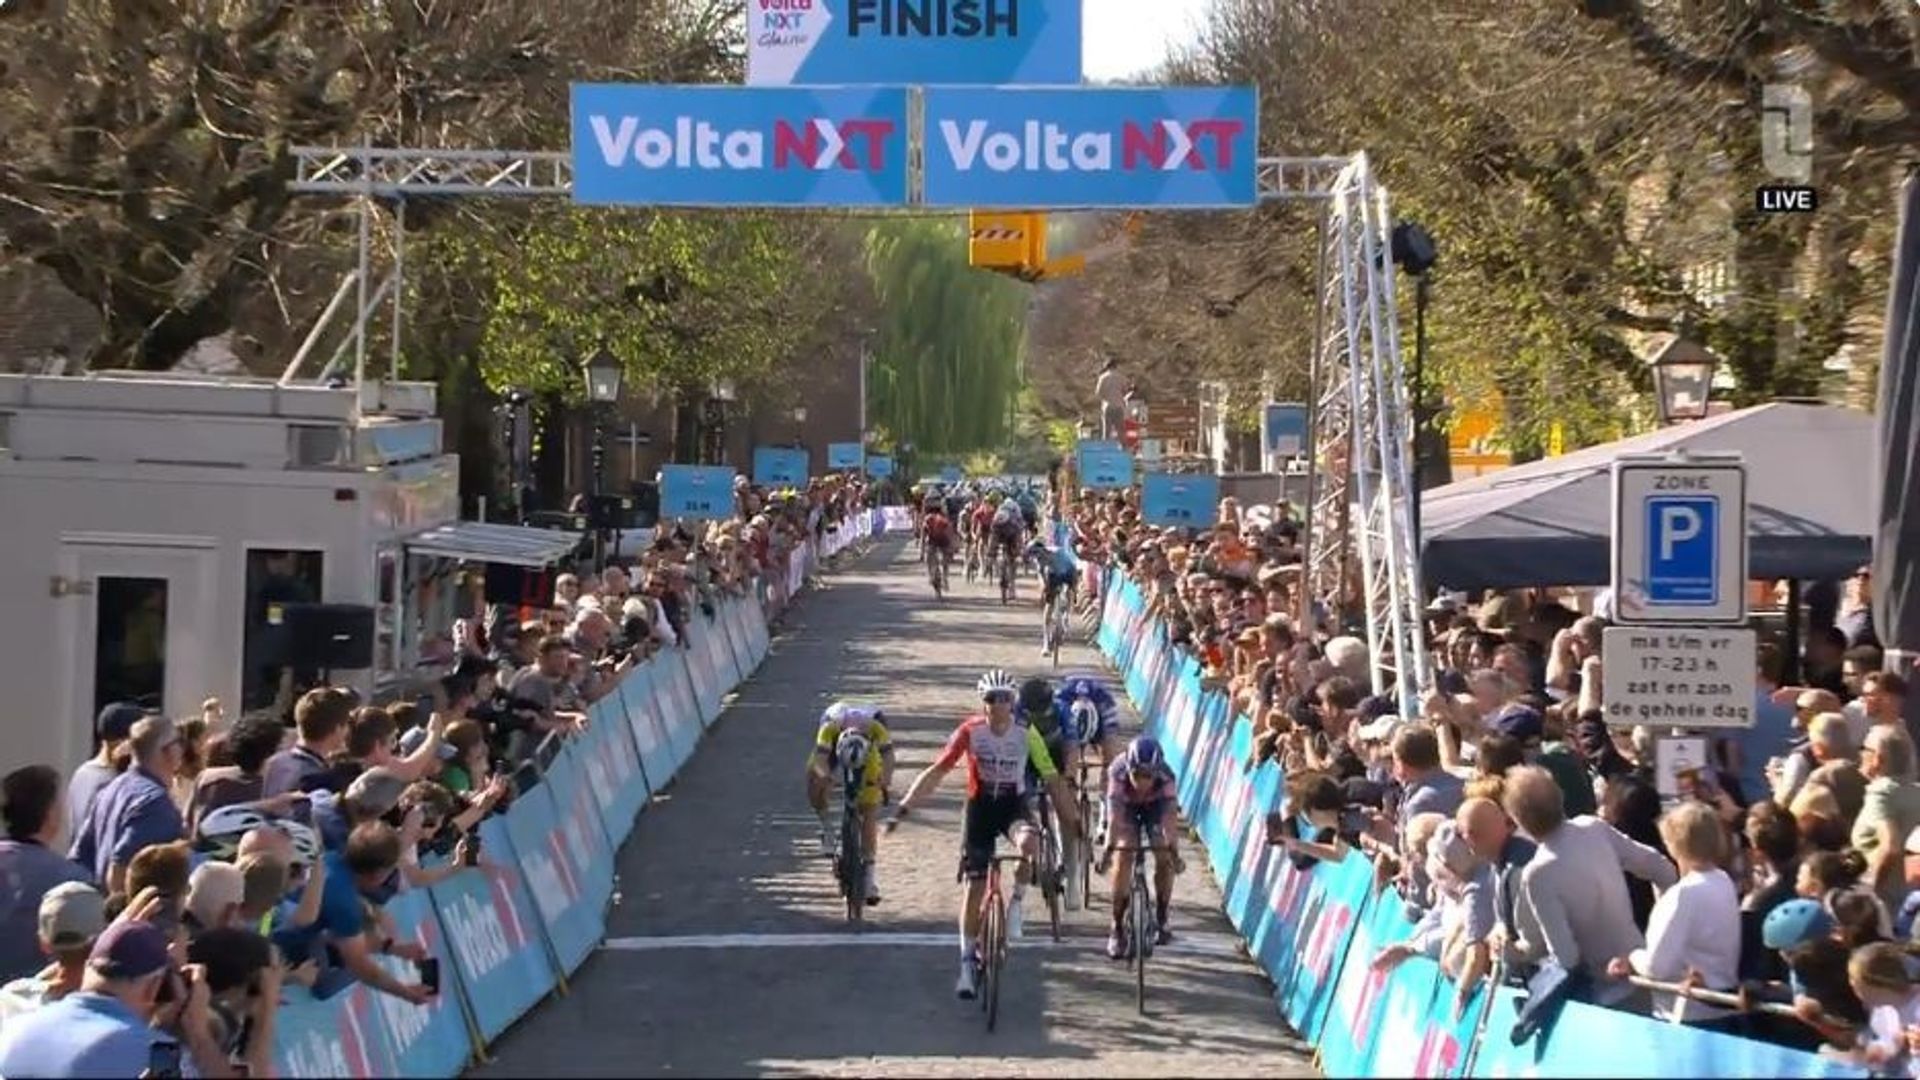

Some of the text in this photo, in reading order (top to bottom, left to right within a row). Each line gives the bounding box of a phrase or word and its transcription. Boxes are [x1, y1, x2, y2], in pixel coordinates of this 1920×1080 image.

[764, 12, 806, 30] NXT
[848, 0, 1019, 37] FINISH
[589, 115, 895, 171] Volta NXT
[939, 118, 1243, 172] Volta NXT
[1653, 475, 1711, 490] ZONE
[1661, 506, 1701, 560] P
[1667, 635, 1702, 649] t/m
[1710, 639, 1731, 648] vr
[1641, 656, 1718, 671] 17-23 h
[1627, 681, 1732, 695] zat en zon
[1610, 702, 1749, 721] de gehele dag
